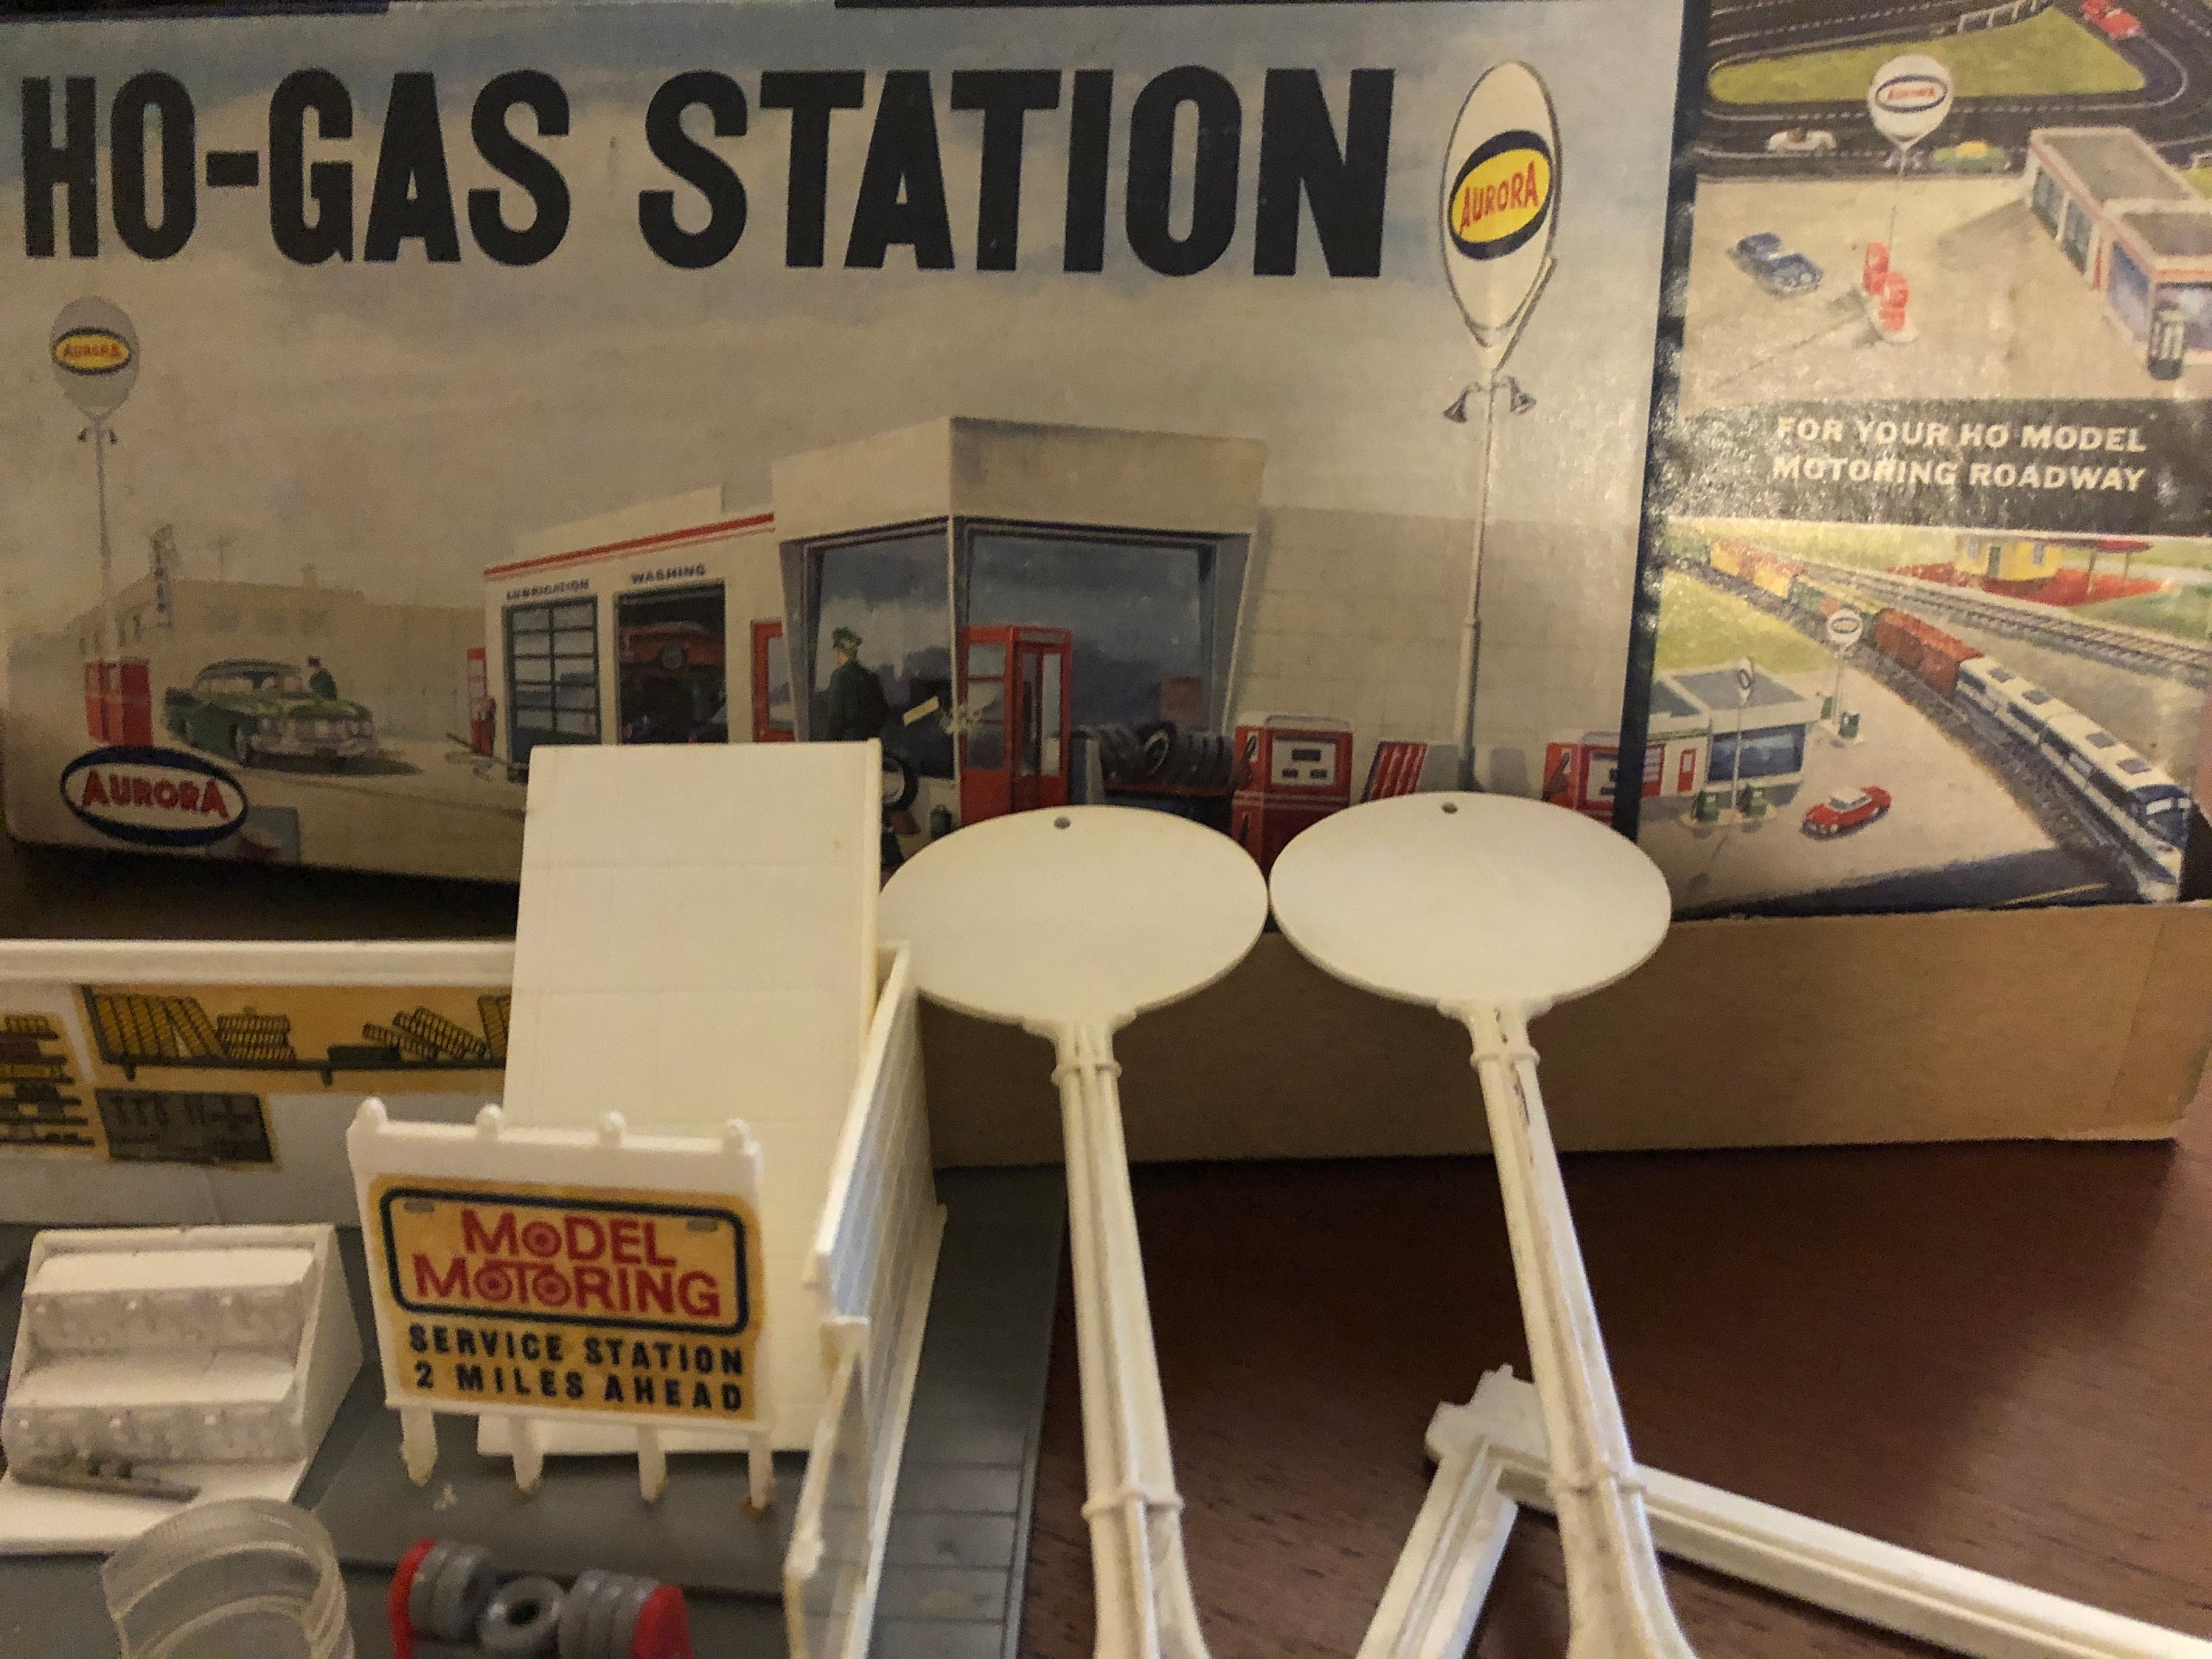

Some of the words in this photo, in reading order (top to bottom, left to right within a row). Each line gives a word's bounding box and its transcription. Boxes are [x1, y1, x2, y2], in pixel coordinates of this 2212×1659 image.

[21, 69, 571, 266] HO-GAS
[638, 64, 1396, 278] STATION
[1459, 160, 1539, 237] AURORA
[1777, 417, 1844, 443] FOR
[1856, 420, 1949, 448] YOUR
[1960, 422, 2010, 448] HO
[2020, 425, 2147, 453] MODEL
[1773, 456, 1958, 487] MOTORING
[1969, 463, 2147, 493] ROADWAY
[632, 563, 706, 585] WASHING
[81, 768, 229, 820] AURORA
[408, 1324, 563, 1363] SERVICE
[584, 1336, 743, 1375] STATION
[414, 1360, 434, 1390] 2
[456, 1363, 585, 1399] MILES
[603, 1374, 742, 1411] AHEAD
